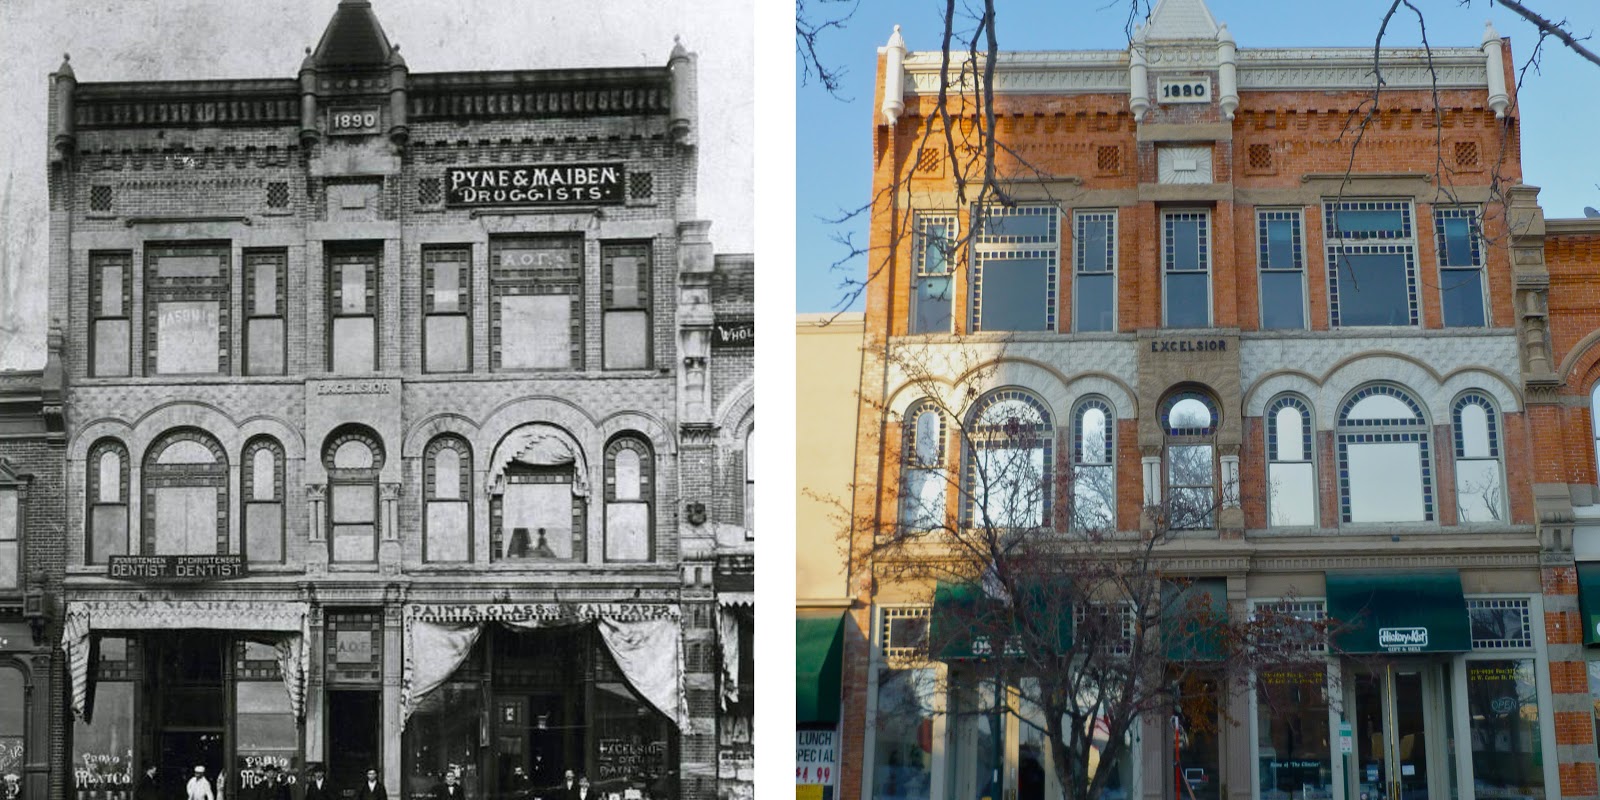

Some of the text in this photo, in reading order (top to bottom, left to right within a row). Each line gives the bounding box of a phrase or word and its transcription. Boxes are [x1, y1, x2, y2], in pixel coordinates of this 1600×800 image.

[1163, 84, 1205, 97] 1890
[335, 113, 375, 128] 1890
[451, 167, 616, 190] PYNE & MAIBEN
[457, 186, 601, 203] DRUGGISTS
[1151, 339, 1227, 353] EXCELSIOR
[317, 382, 390, 396] EXCELSIOR
[1491, 700, 1517, 711] OPEN
[798, 732, 832, 746] LUNCH
[796, 748, 835, 763] PECIAL
